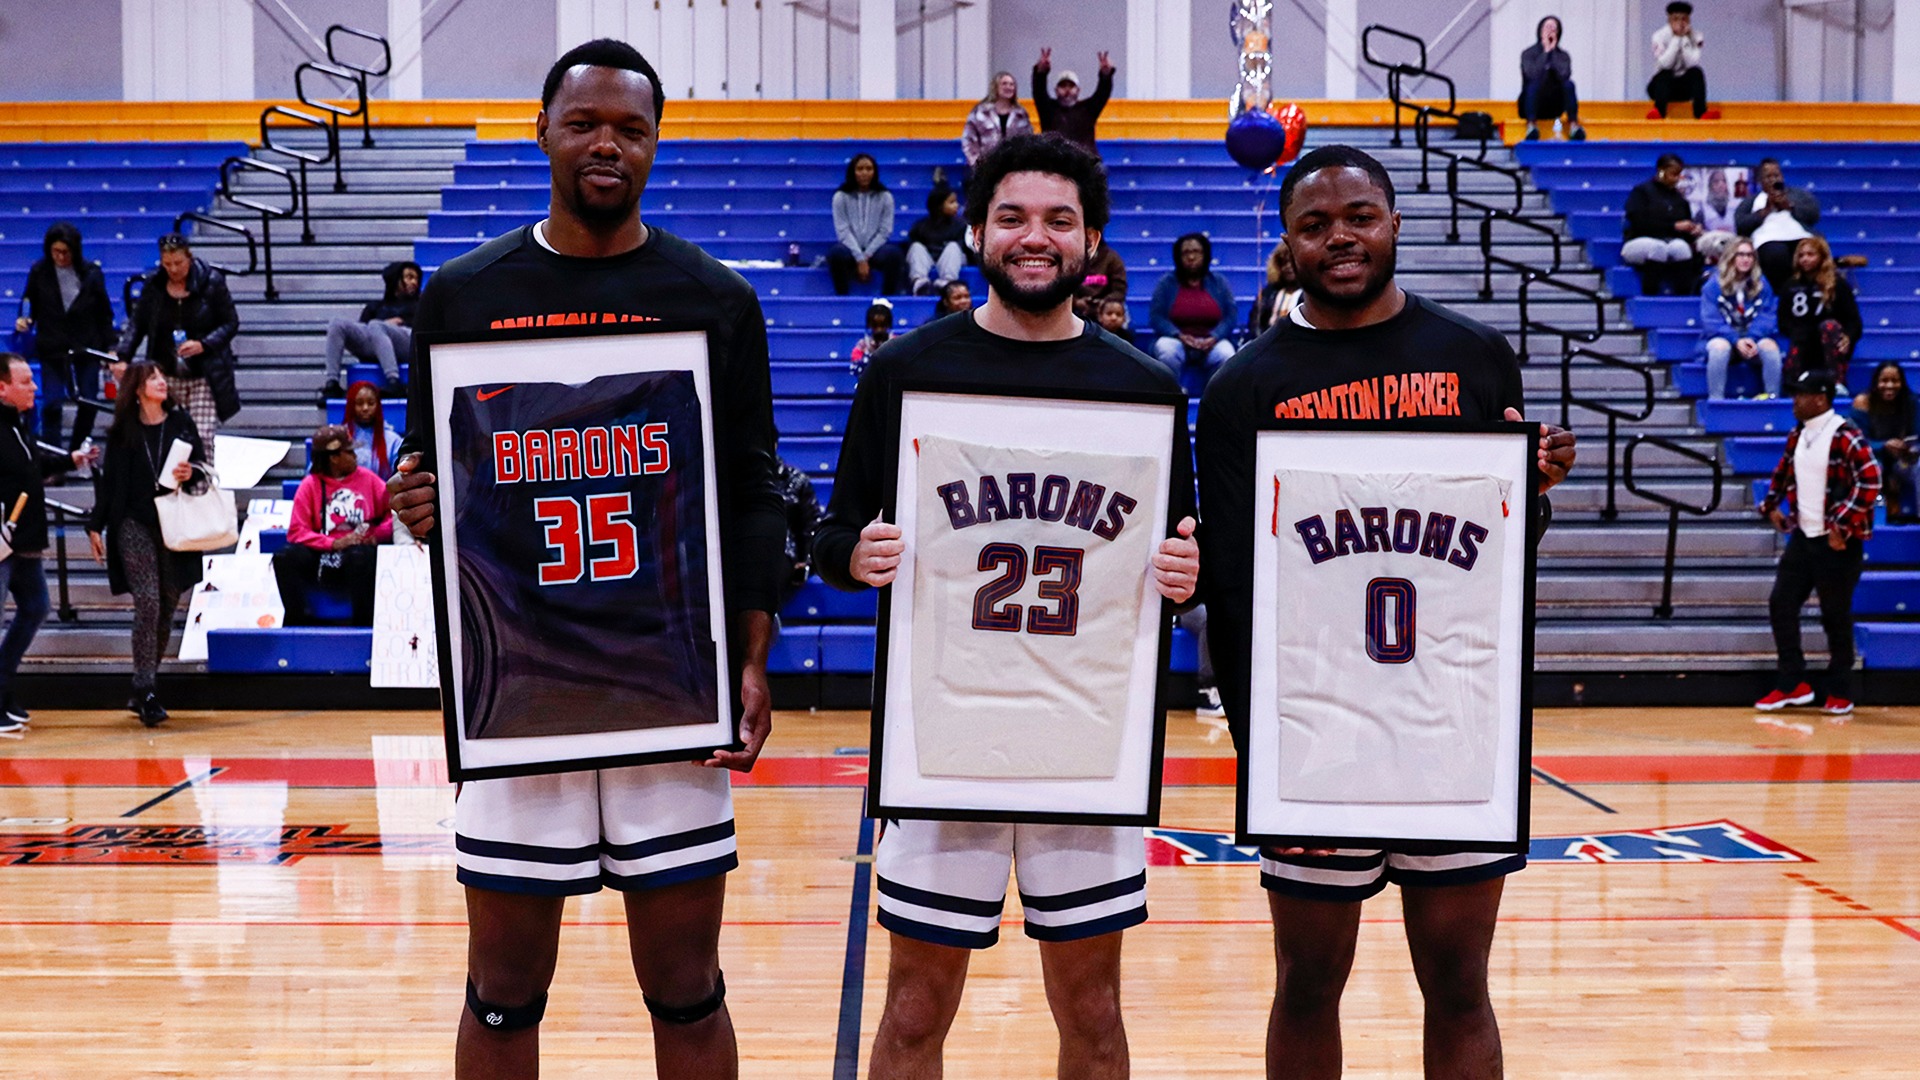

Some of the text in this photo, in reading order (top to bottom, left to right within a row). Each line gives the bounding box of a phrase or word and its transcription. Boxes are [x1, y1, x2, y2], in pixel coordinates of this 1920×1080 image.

[1792, 291, 1824, 317] 87
[1384, 372, 1461, 420] PARKER
[492, 422, 670, 485] BARONS
[533, 491, 640, 586] 35
[936, 472, 1138, 541] BARONS
[1294, 507, 1489, 571] BARONS
[971, 542, 1085, 636] 23
[1365, 577, 1417, 664] 0
